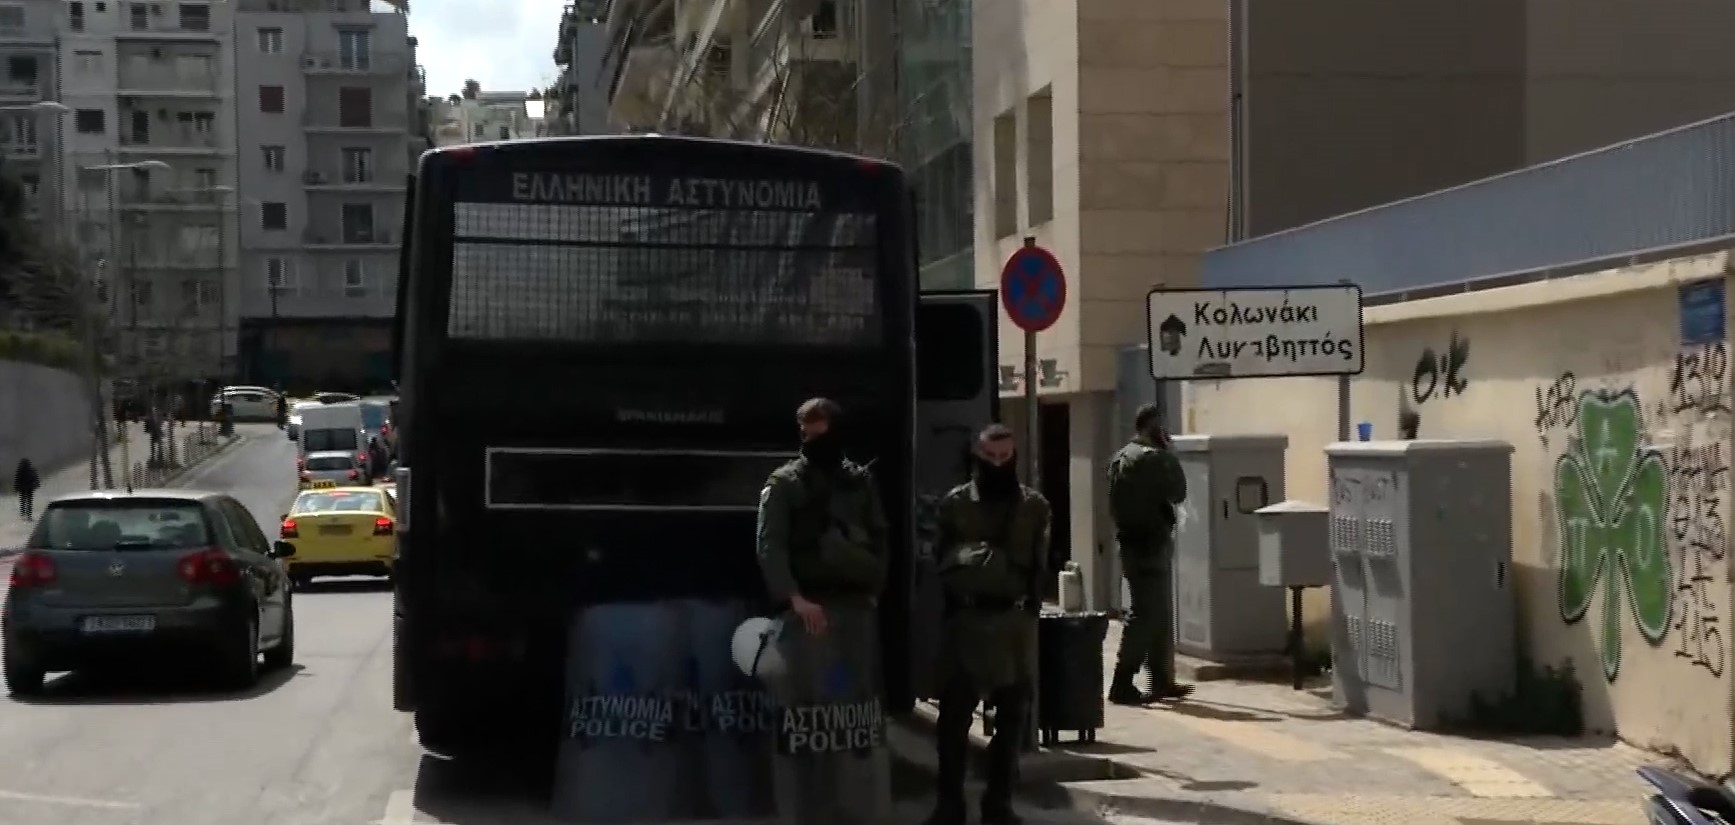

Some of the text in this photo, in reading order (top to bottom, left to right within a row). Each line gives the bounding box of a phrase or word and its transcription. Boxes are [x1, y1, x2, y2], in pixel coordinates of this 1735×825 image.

[512, 173, 822, 208] ΕΛΛΗΝΙΚΗ ΑΣΤΥΝΟΜΙΑ
[1193, 299, 1318, 325] Κολωνάκι
[569, 696, 673, 723] ΑΣΤΥΝΟΜΙΑ
[783, 697, 882, 733] ΑΣΤΥΝΟΜΙΑ
[570, 719, 665, 742] POLICE
[790, 728, 880, 753] POLICE
